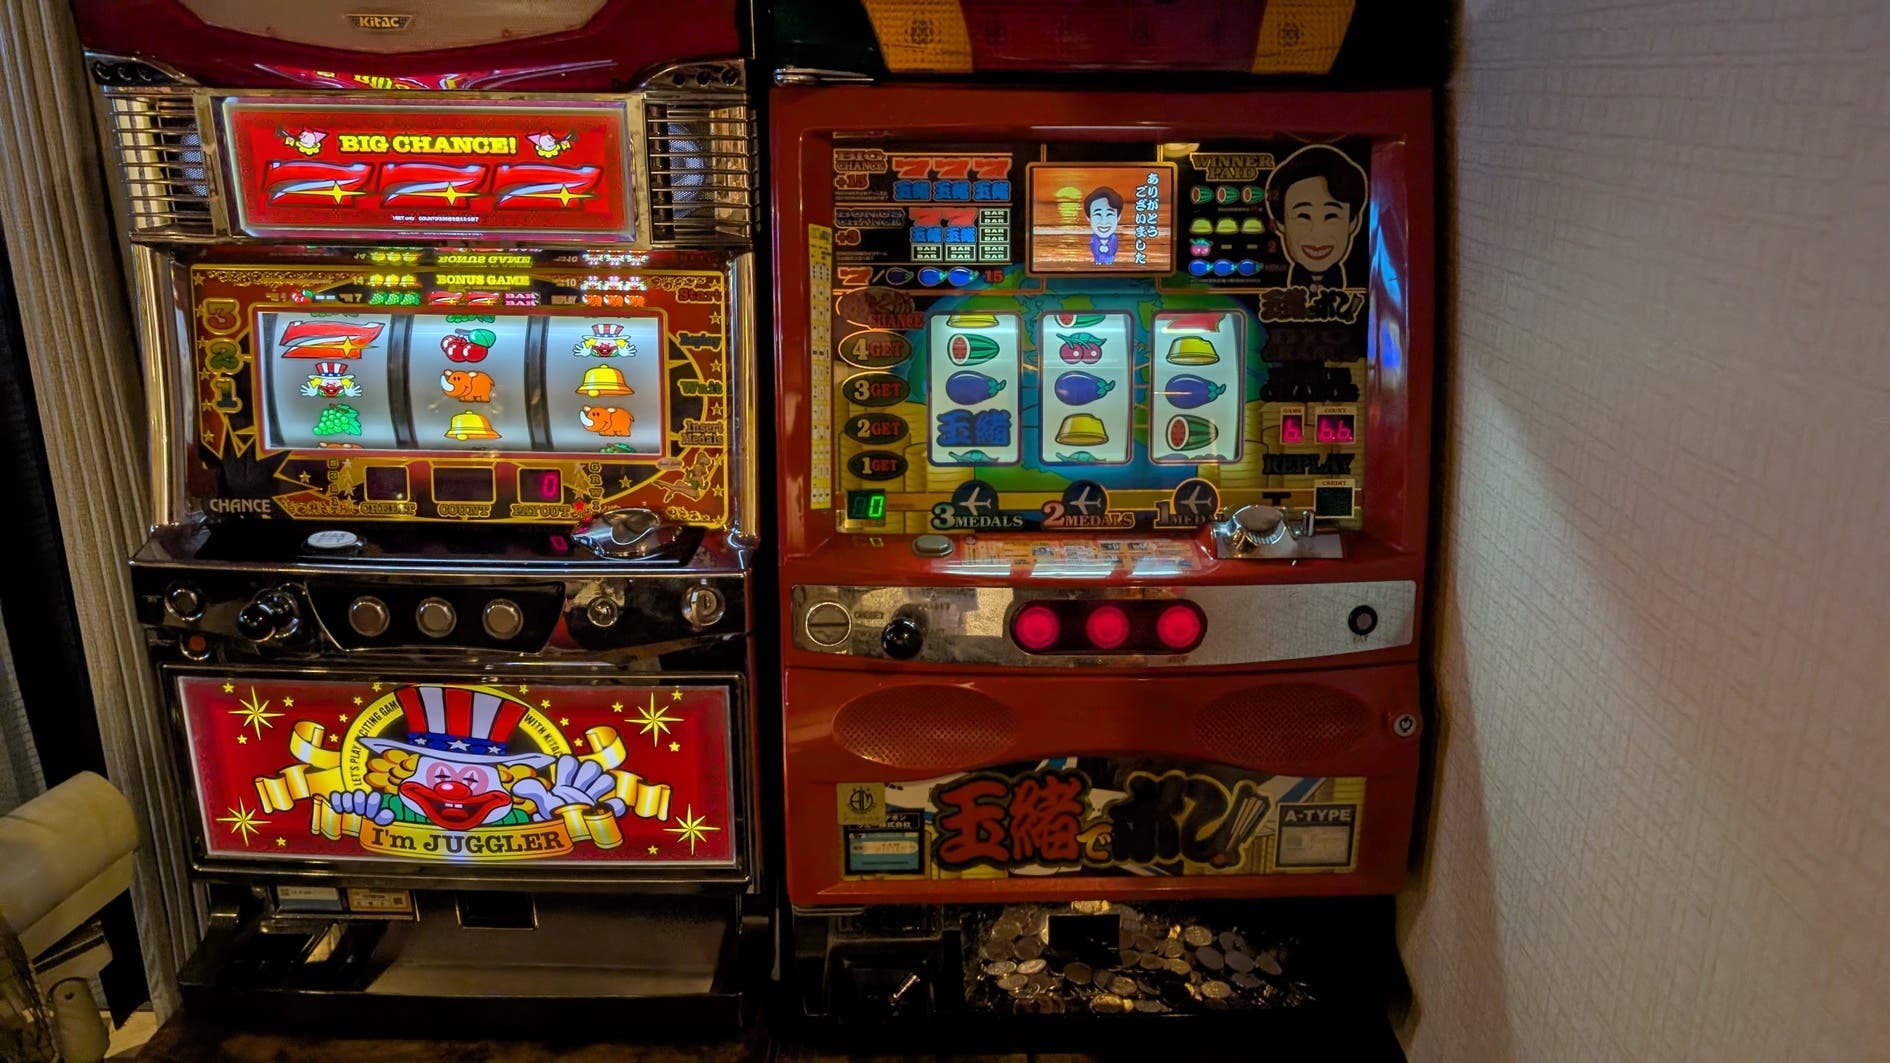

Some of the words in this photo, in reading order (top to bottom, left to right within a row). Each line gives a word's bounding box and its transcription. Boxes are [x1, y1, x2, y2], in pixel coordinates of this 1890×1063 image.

[339, 135, 389, 153] BIG
[391, 136, 518, 154] CHANCE!
[838, 151, 885, 160] BIG
[1192, 155, 1274, 168] WINNER
[1207, 167, 1257, 179] PAID
[1146, 172, 1159, 238] ありがとう
[1135, 186, 1148, 265] ございました
[436, 274, 485, 286] BONUS
[486, 275, 530, 286] GAME
[565, 278, 577, 288] 10
[984, 269, 1004, 283] 15
[677, 289, 722, 302] Start
[215, 381, 240, 410] 1
[541, 474, 558, 497] 0
[210, 499, 272, 514] CHANCE
[439, 504, 490, 515] COUNT
[868, 496, 885, 517] 0
[379, 700, 400, 717] GAM
[358, 711, 382, 738] CITING
[524, 713, 546, 735] WITH
[350, 744, 362, 764] PLAY
[351, 765, 362, 786] LET'S
[1284, 808, 1353, 823] A-TYPE
[371, 827, 417, 850] I'm
[423, 831, 565, 854] JUGGLER
